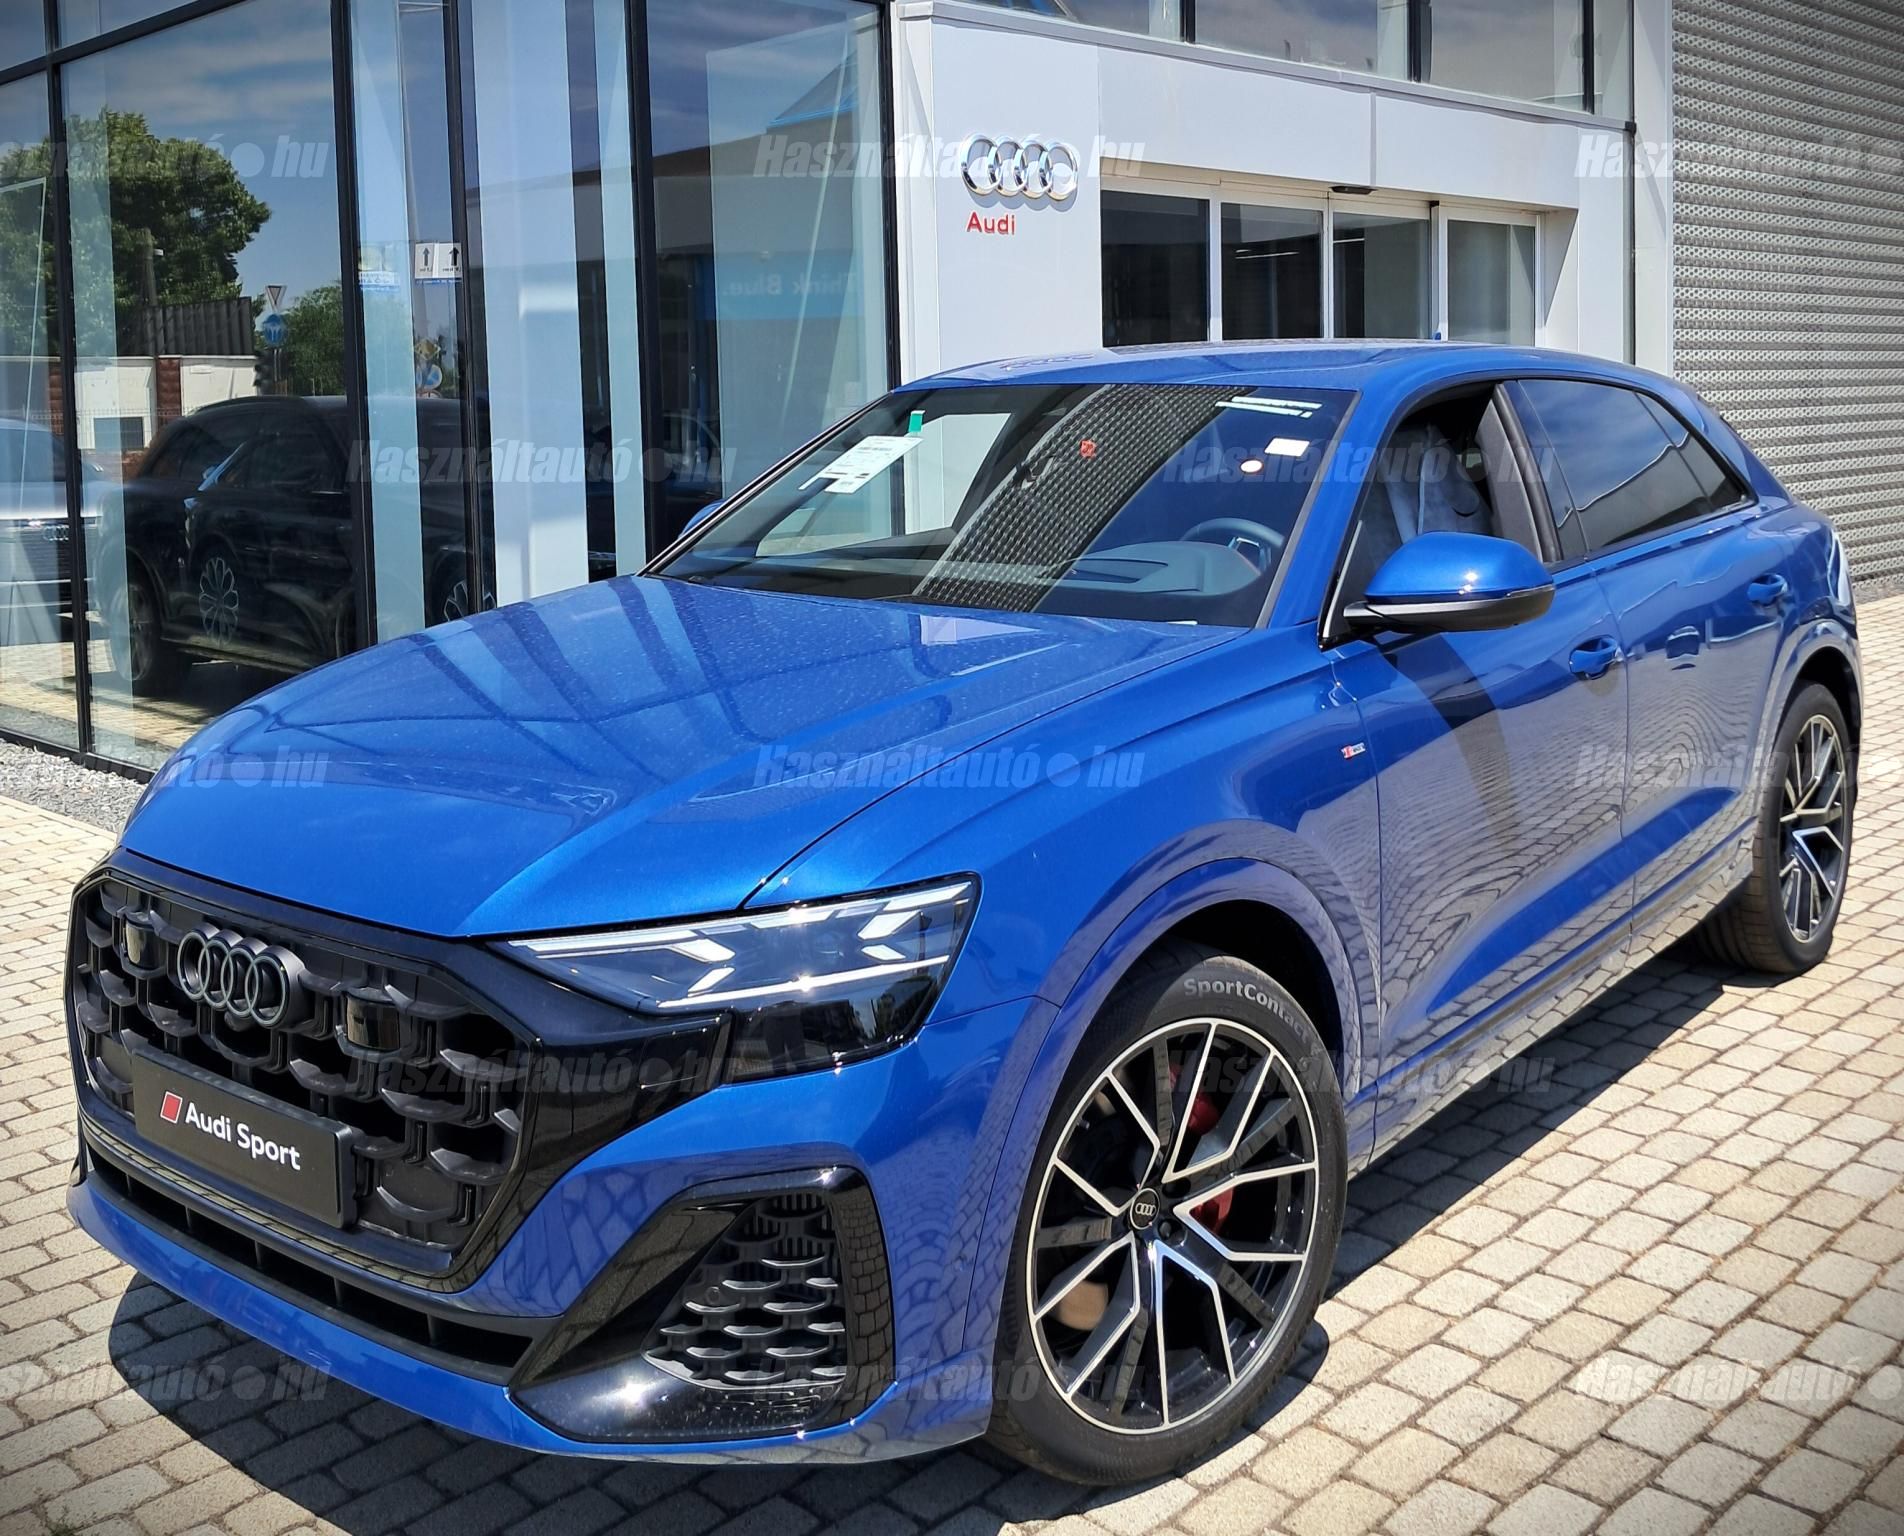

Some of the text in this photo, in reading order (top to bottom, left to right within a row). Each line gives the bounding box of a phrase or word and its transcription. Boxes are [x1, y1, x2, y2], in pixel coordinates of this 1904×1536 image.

[966, 211, 1016, 235] Audi
[185, 1102, 301, 1171] Audi Sport
